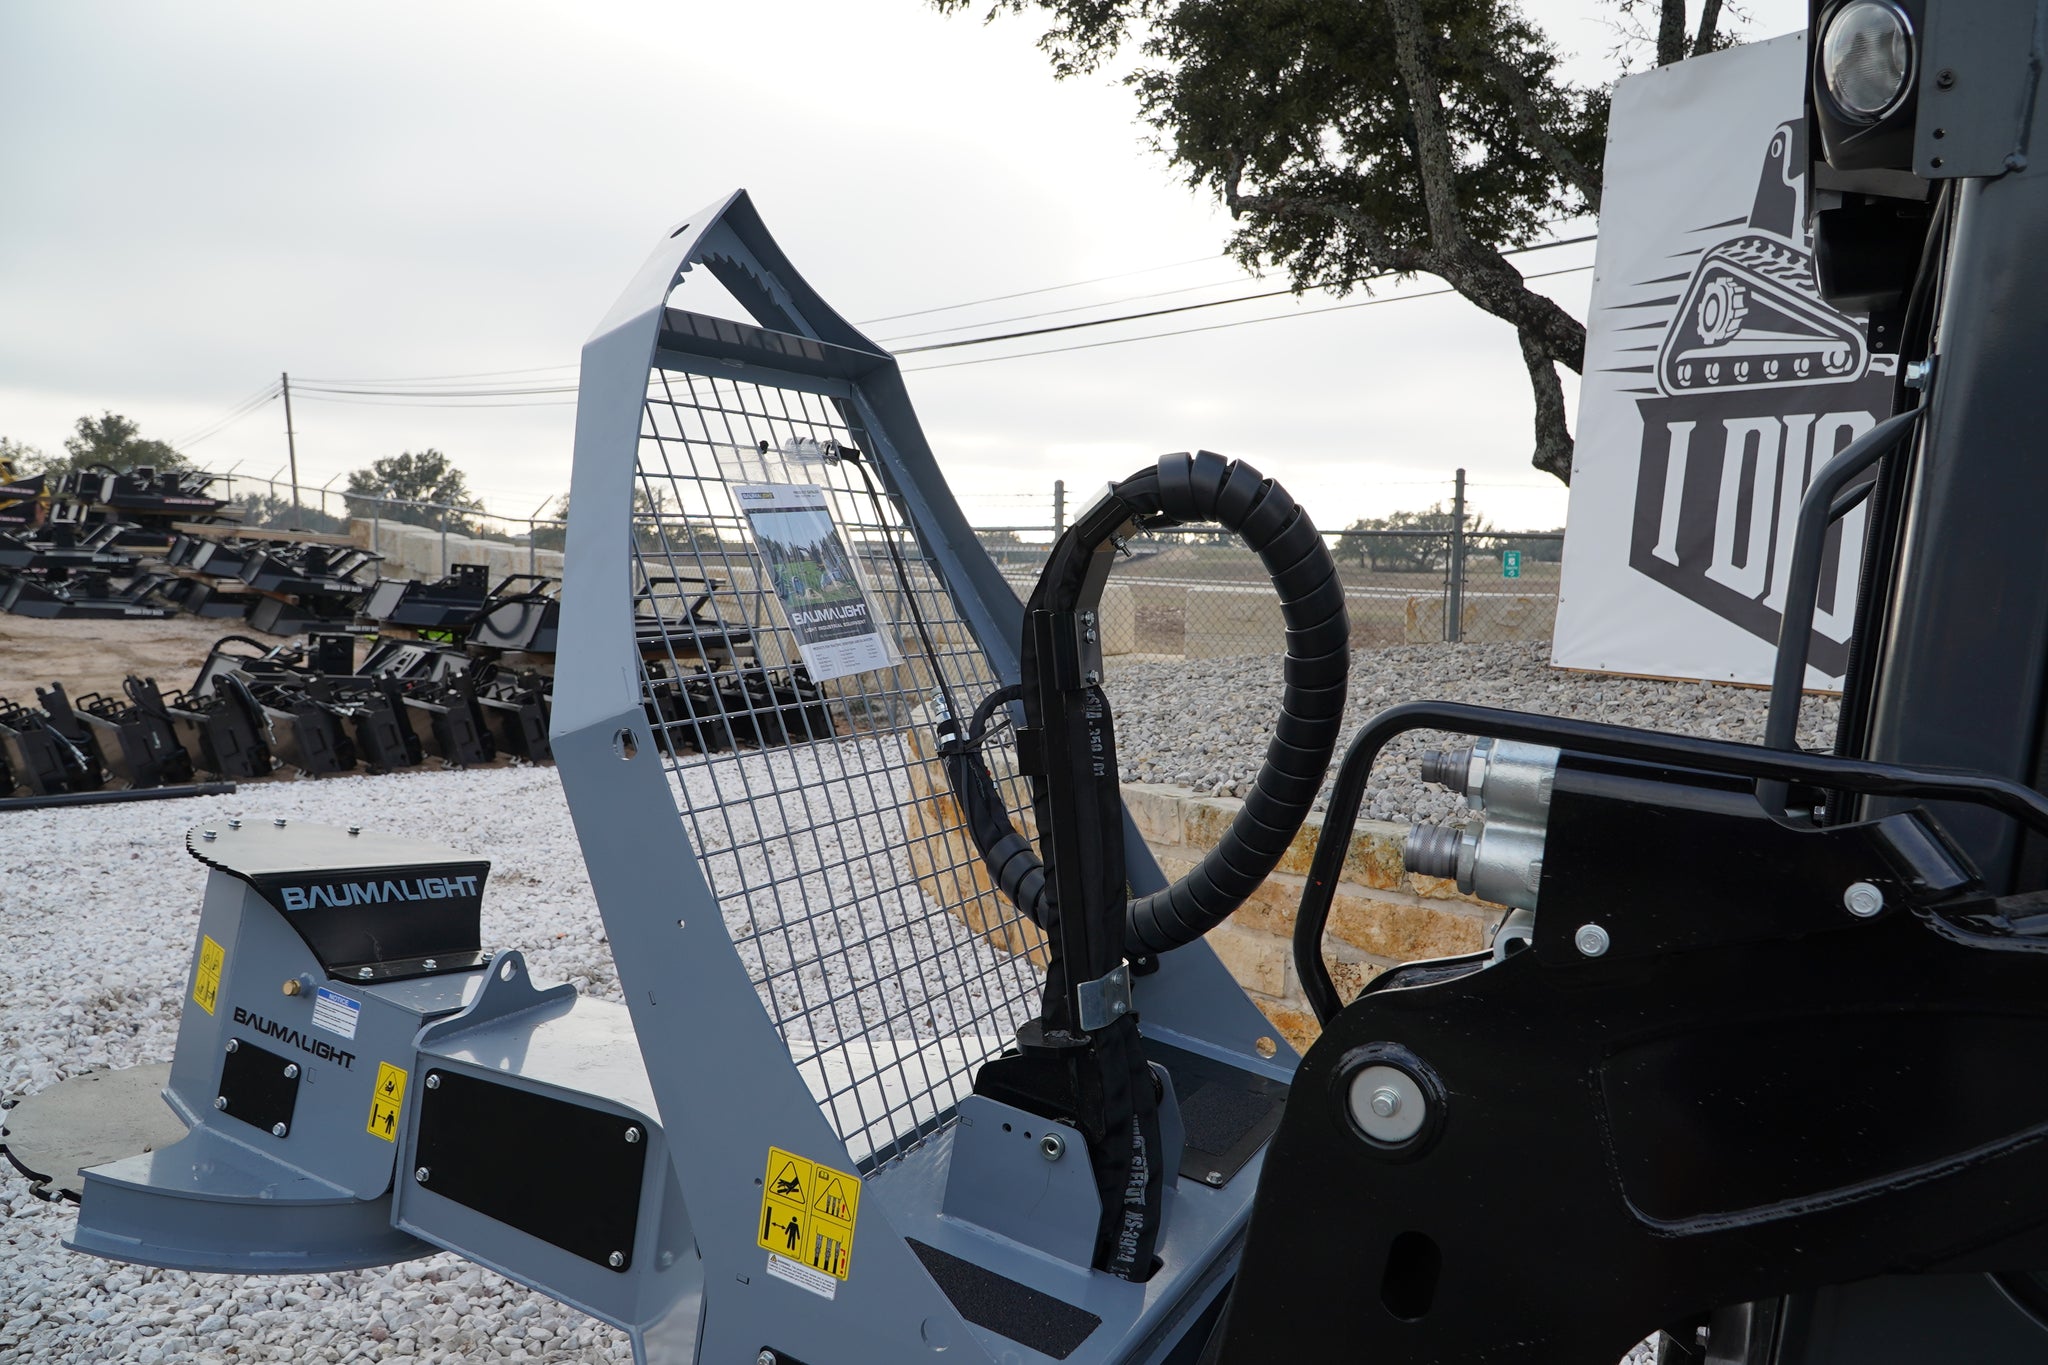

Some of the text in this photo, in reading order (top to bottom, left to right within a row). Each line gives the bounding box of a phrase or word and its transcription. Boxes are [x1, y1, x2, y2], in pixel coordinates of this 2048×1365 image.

[1651, 410, 1877, 646] I DIG
[792, 604, 866, 625] BAUMALIGHT
[280, 875, 478, 911] BAUMALIGHT
[328, 993, 349, 1007] NOTICE
[233, 1006, 356, 1069] BAUMALIGHT
